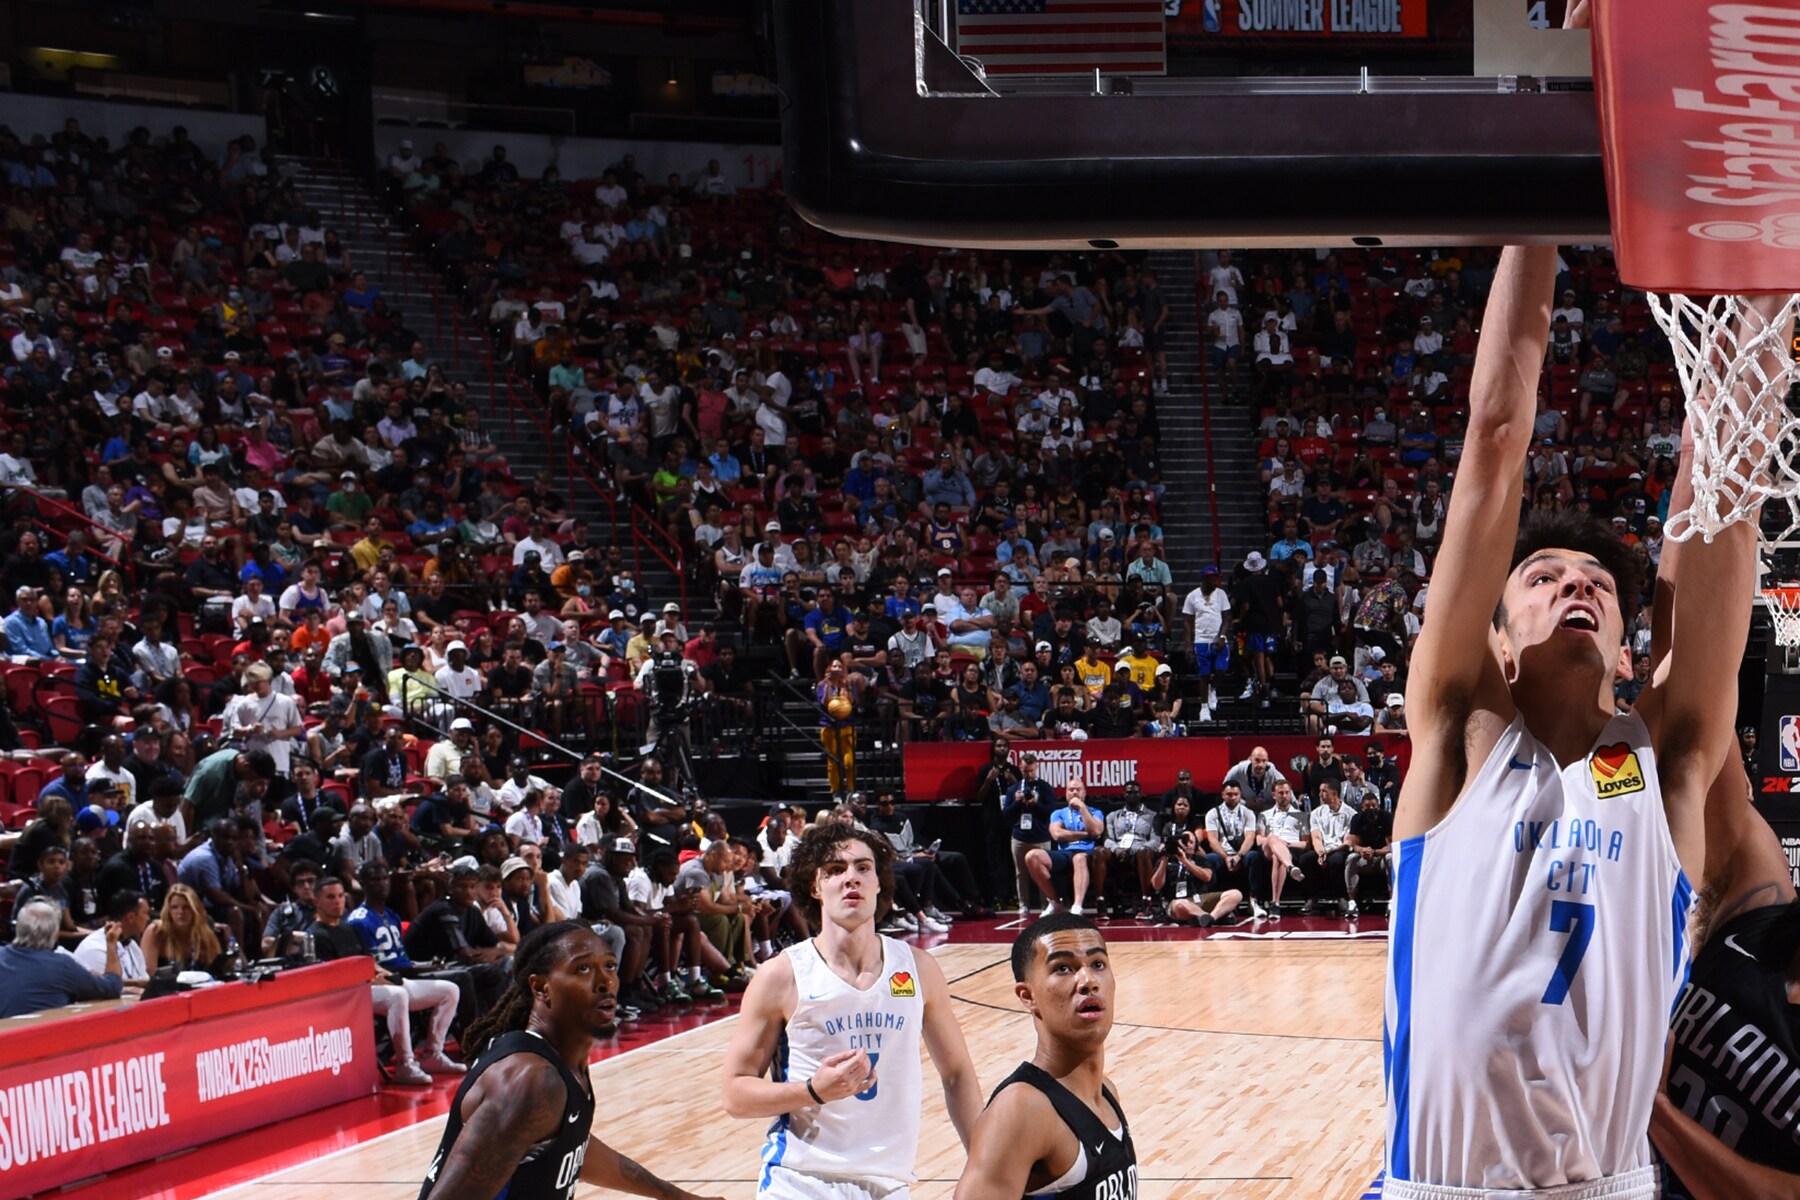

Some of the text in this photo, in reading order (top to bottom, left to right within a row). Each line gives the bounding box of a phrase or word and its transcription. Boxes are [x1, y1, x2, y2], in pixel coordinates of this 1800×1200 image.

[1238, 0, 1402, 33] SUMMER LEAGUE
[1526, 0, 1550, 29] 4
[1037, 759, 1138, 788] MMER LEAGUE
[1783, 757, 1795, 767] NBA
[1540, 900, 1596, 1006] 7
[825, 1011, 906, 1036] OKLAHOMA
[849, 1032, 882, 1050] CITY
[195, 1025, 354, 1103] #NBA2K23SummerLeague
[0, 1051, 171, 1172] SUMMER LEAGUE
